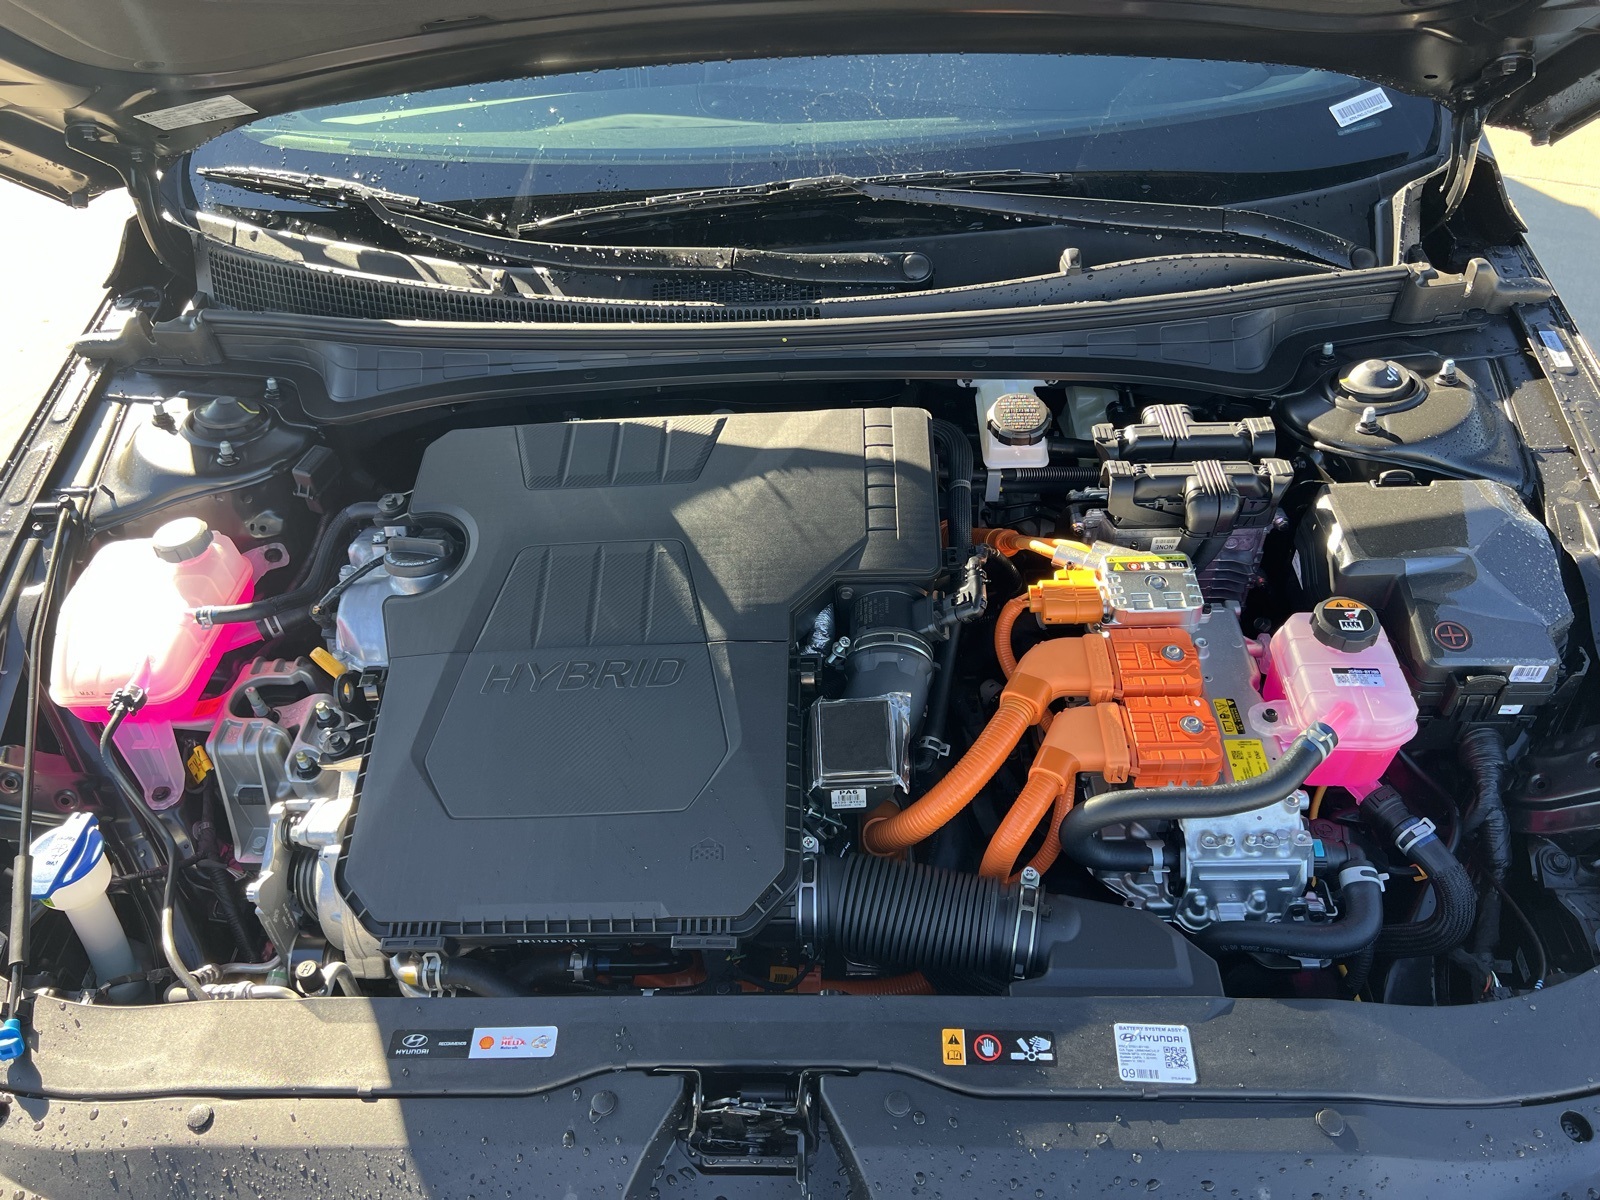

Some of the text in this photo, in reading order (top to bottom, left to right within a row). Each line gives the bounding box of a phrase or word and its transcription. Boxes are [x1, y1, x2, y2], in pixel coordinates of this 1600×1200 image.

[479, 657, 687, 694] HYBRID
[1140, 1034, 1183, 1043] HYUNDAI
[1122, 1068, 1136, 1078] 09
